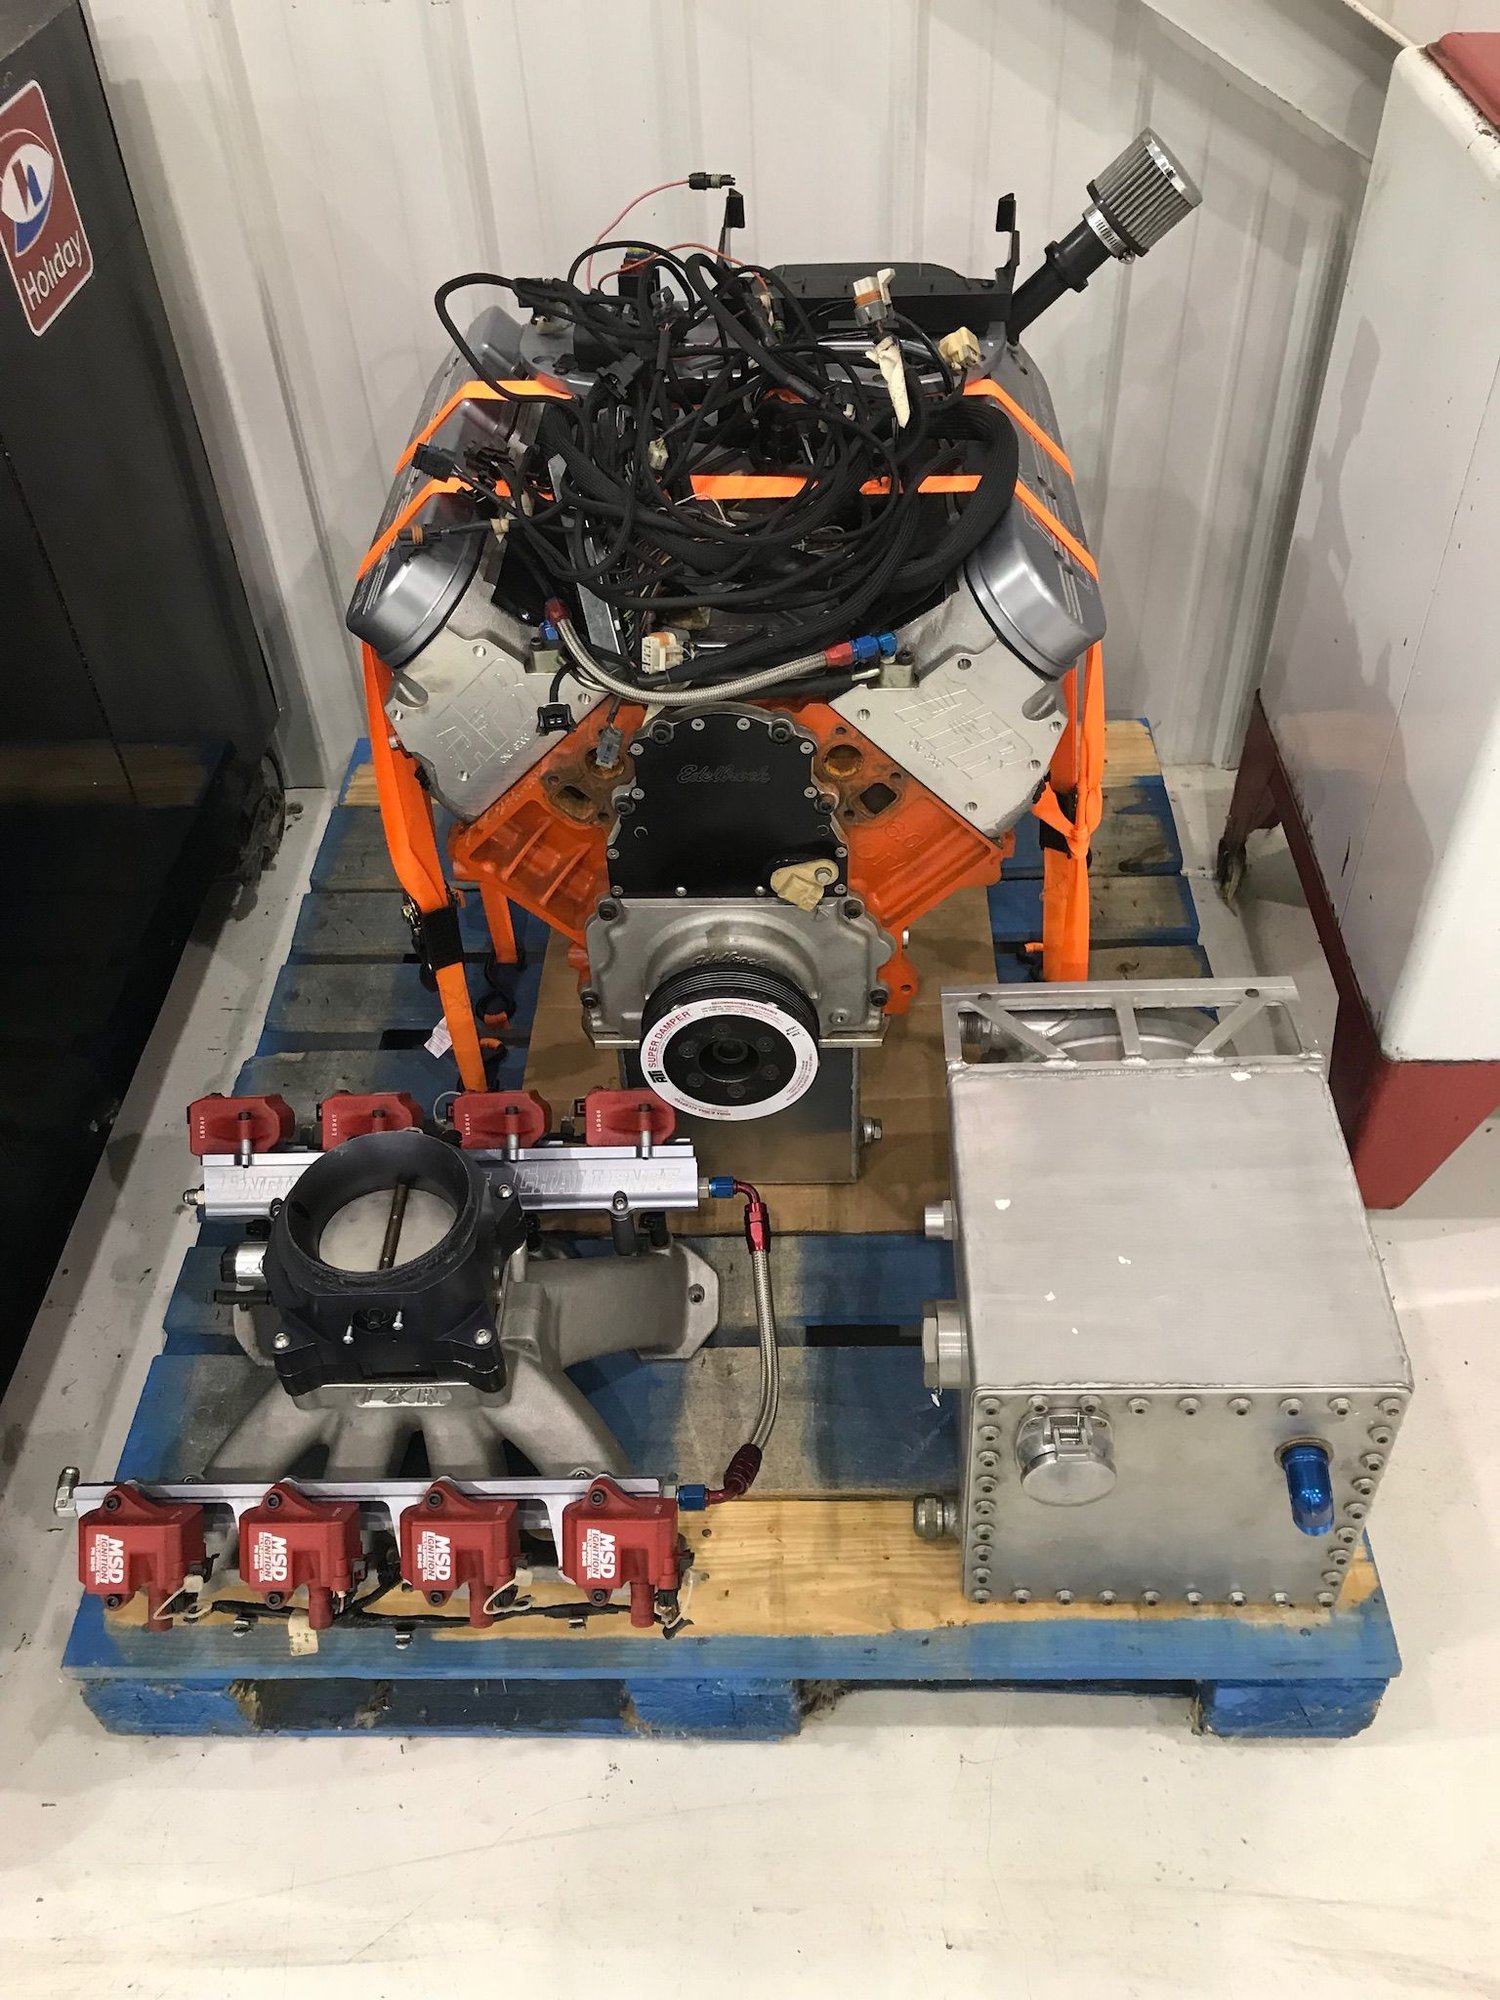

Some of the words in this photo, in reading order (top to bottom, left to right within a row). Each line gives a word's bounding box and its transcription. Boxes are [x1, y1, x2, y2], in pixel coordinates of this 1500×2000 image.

[22, 230, 83, 311] Holiday
[676, 764, 771, 784] Edelbrock
[647, 1040, 660, 1068] SUPER
[654, 1011, 691, 1039] DAMPER
[109, 1538, 124, 1584] MSD
[272, 1536, 287, 1582] MSD
[435, 1536, 451, 1581] MSD
[592, 1533, 600, 1576] IGNITION
[600, 1533, 616, 1579] MSD
